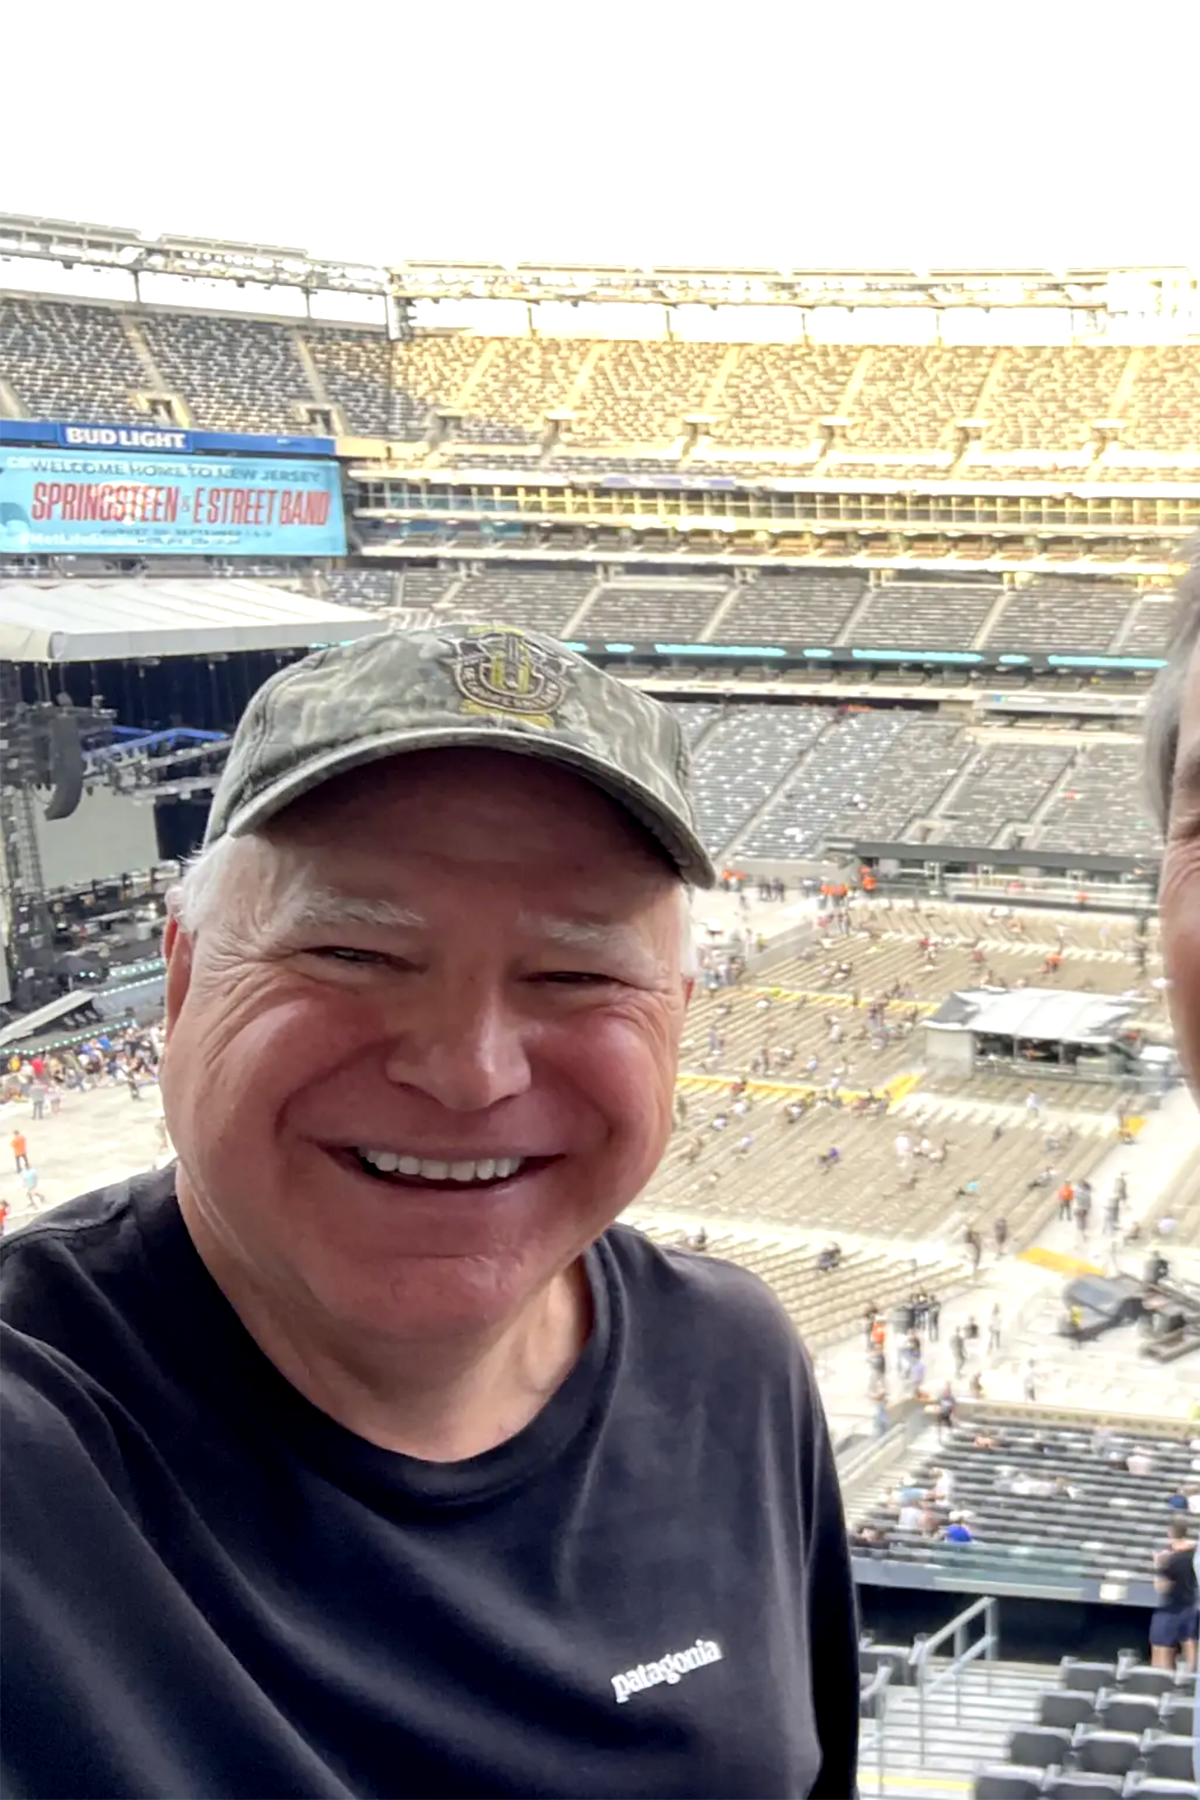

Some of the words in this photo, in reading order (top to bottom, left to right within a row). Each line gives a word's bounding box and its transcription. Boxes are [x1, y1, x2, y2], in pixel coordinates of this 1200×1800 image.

[66, 426, 117, 445] BUD
[118, 429, 186, 448] LIGHT
[31, 459, 124, 475] WELCOME
[129, 463, 185, 477] HOME
[187, 465, 212, 479] TO
[217, 467, 257, 481] NEW
[260, 468, 321, 483] JERSEY
[32, 482, 180, 523] SPRINGSTEEN
[193, 486, 206, 524] E
[206, 487, 278, 525] STREET
[279, 490, 331, 526] BAND
[611, 1638, 723, 1704] patagonia
